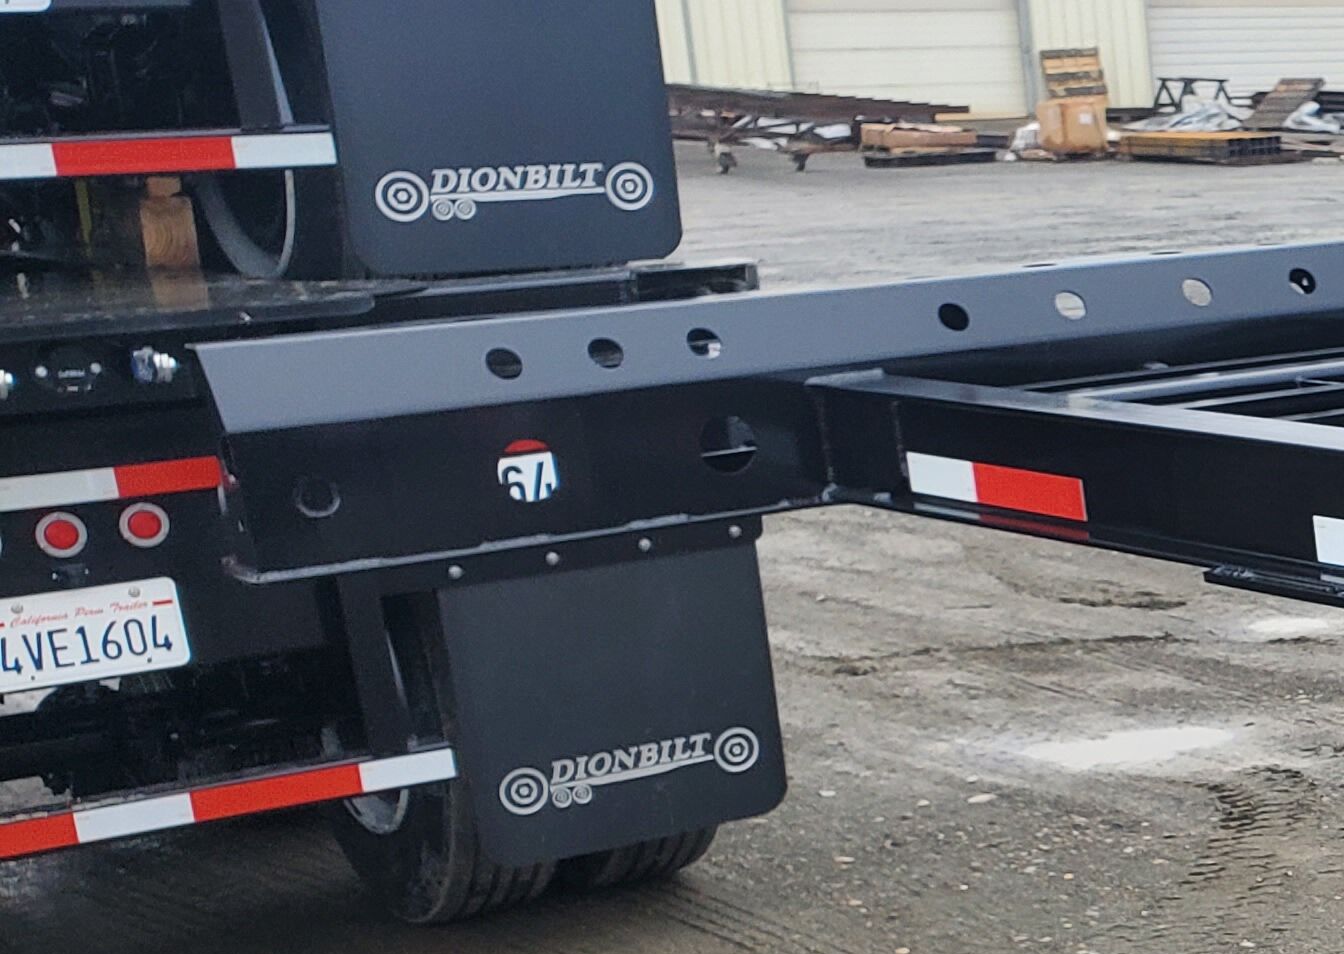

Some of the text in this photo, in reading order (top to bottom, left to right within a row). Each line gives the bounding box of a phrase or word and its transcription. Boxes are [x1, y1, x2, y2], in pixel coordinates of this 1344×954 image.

[430, 162, 603, 194] DIONBILT
[10, 612, 68, 628] California
[110, 600, 148, 612] Trailer
[0, 614, 173, 674] 4VE1604
[551, 733, 711, 784] DIONBILT
